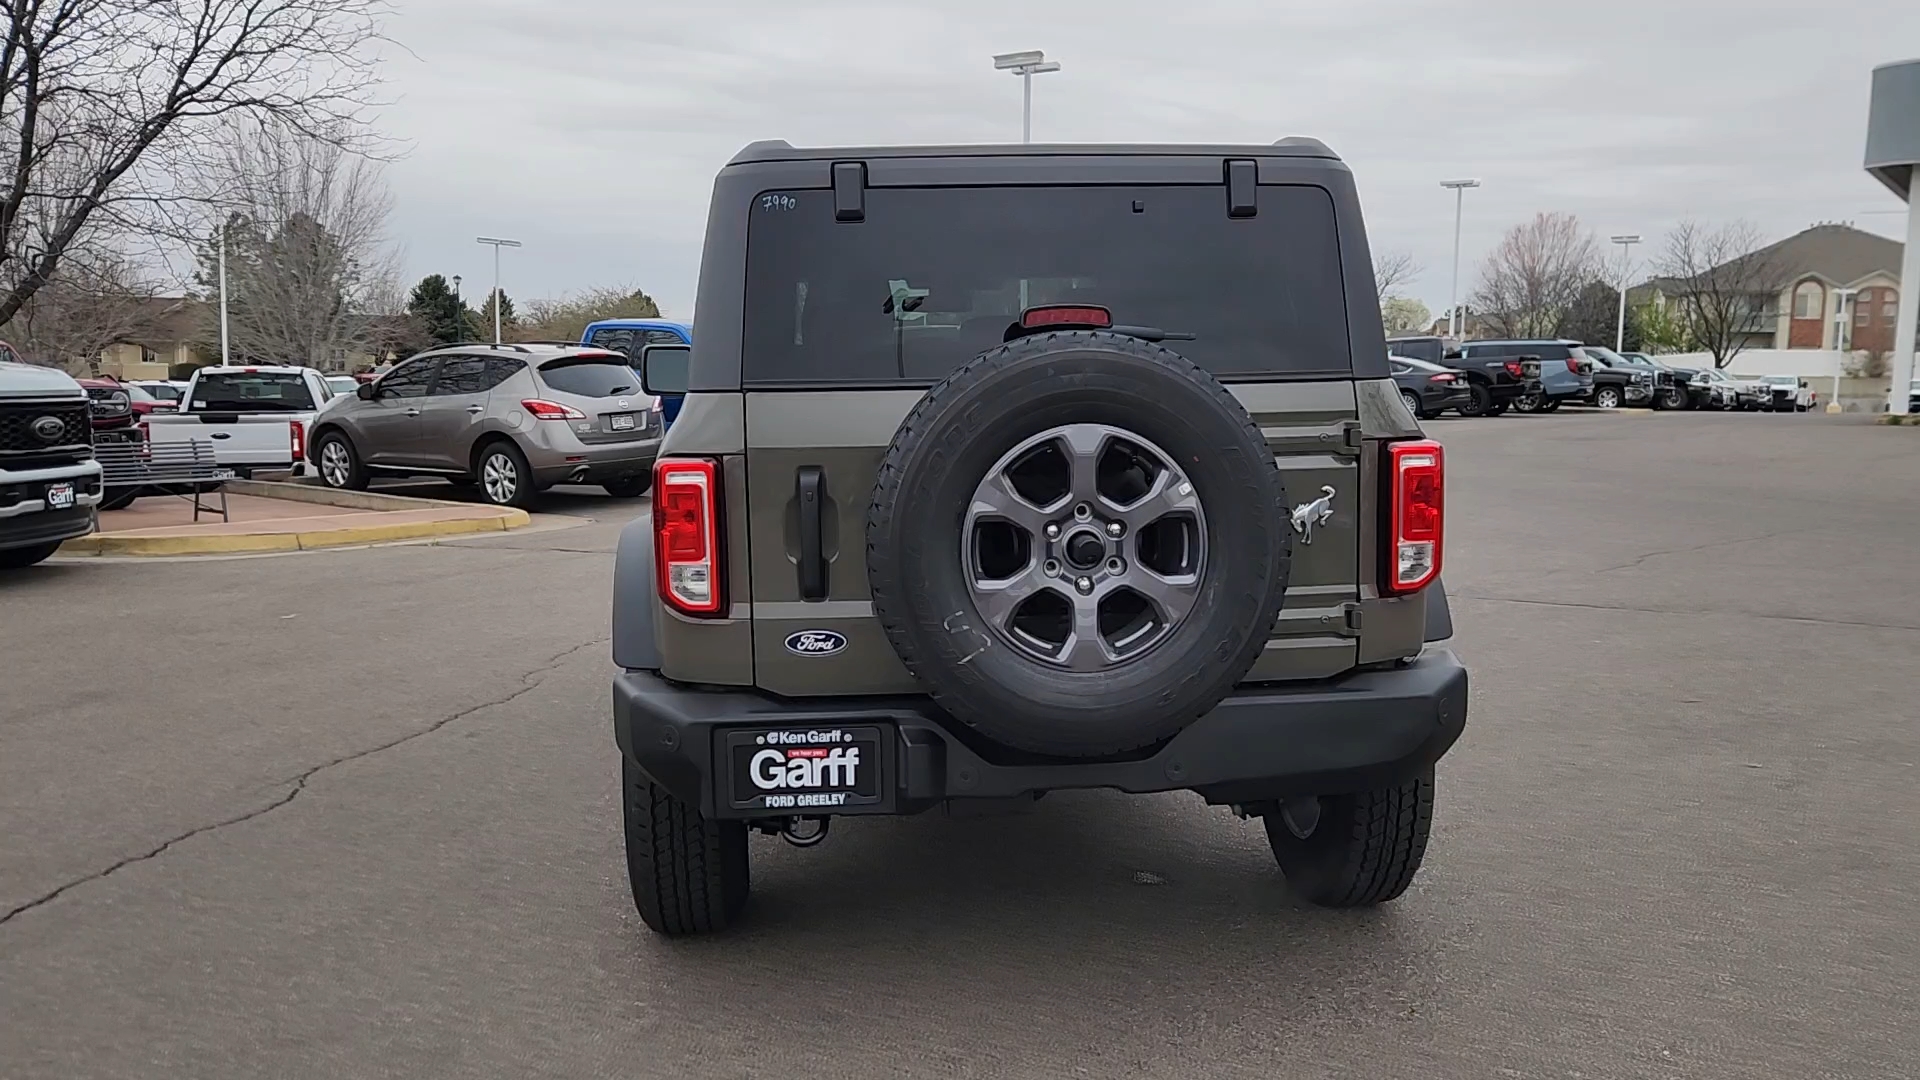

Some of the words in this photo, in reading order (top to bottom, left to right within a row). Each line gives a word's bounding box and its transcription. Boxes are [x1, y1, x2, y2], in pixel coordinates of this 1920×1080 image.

[762, 195, 796, 212] 7990
[48, 487, 74, 505] Garff
[797, 634, 835, 650] Ford
[780, 732, 806, 744] Ken
[807, 730, 841, 743] Garff
[750, 747, 859, 790] Garff
[766, 796, 795, 807] FORD
[797, 793, 846, 807] GREELEY
